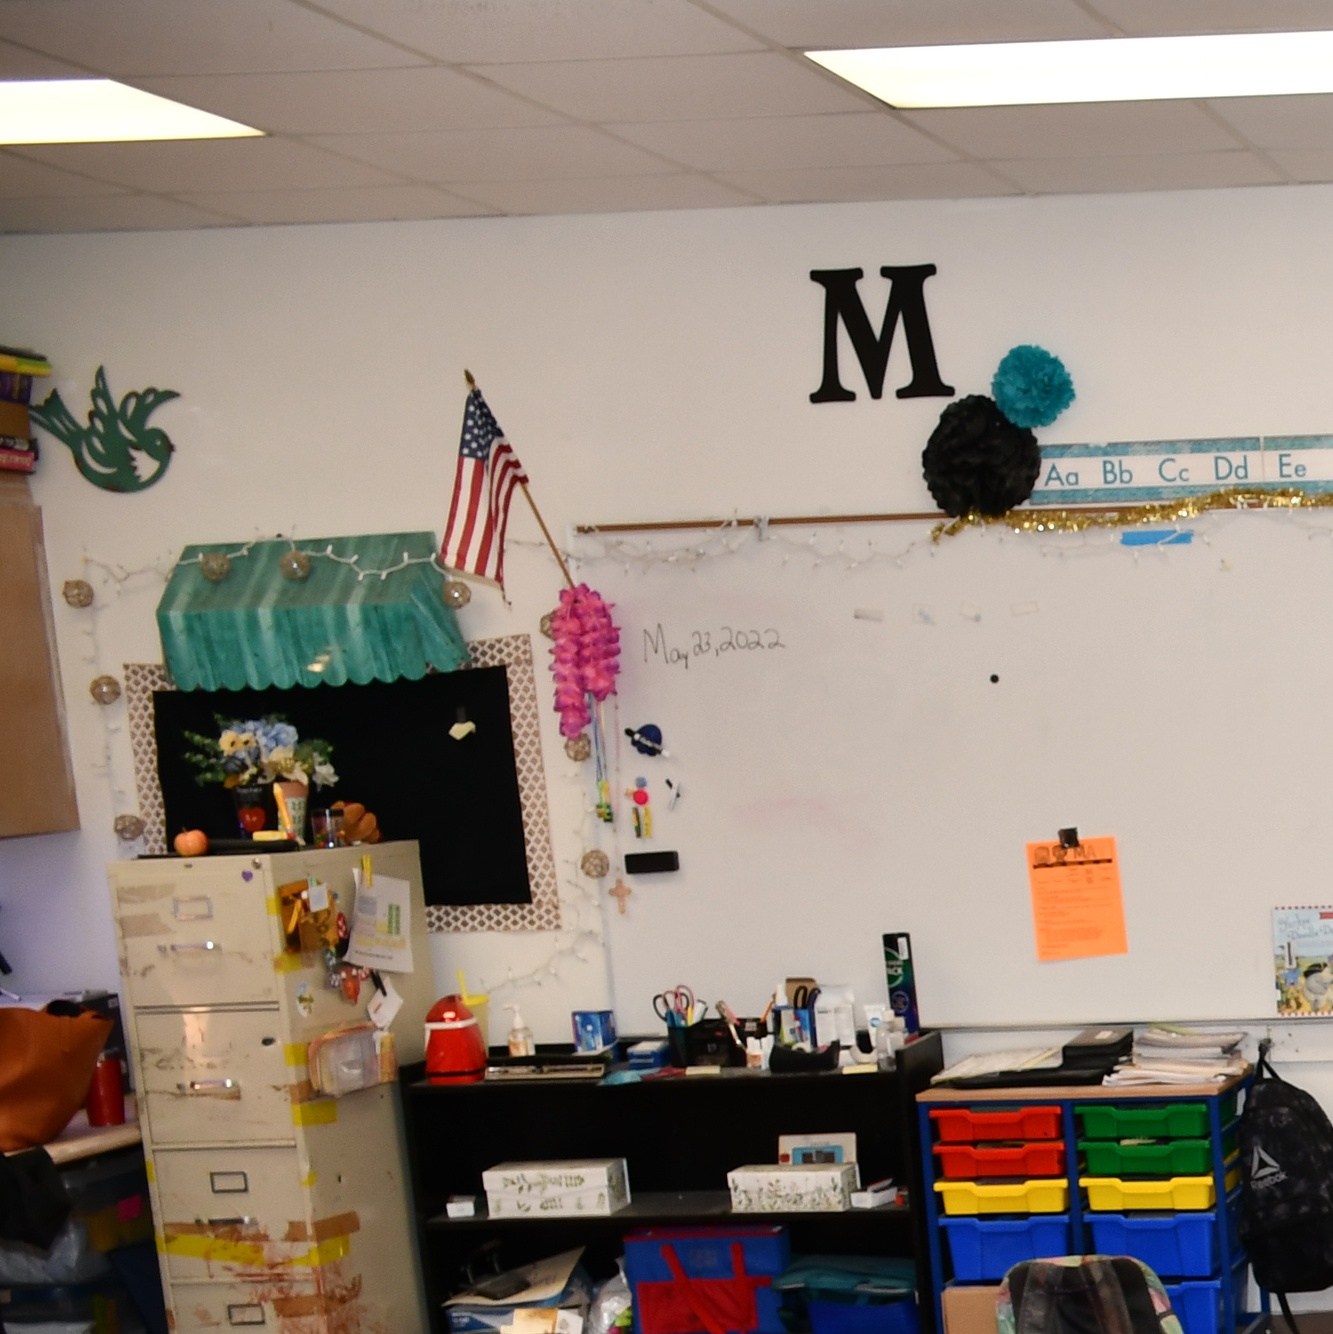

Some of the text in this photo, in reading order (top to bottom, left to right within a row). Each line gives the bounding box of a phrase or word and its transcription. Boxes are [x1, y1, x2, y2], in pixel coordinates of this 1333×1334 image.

[808, 263, 956, 404] M
[1044, 463, 1079, 487] Aa
[1102, 460, 1133, 484] Bb
[1158, 458, 1190, 483] Cc
[1214, 455, 1249, 480] Dd
[1278, 453, 1307, 479] Ee
[642, 622, 690, 670] May
[1250, 1171, 1288, 1191] Reebok
